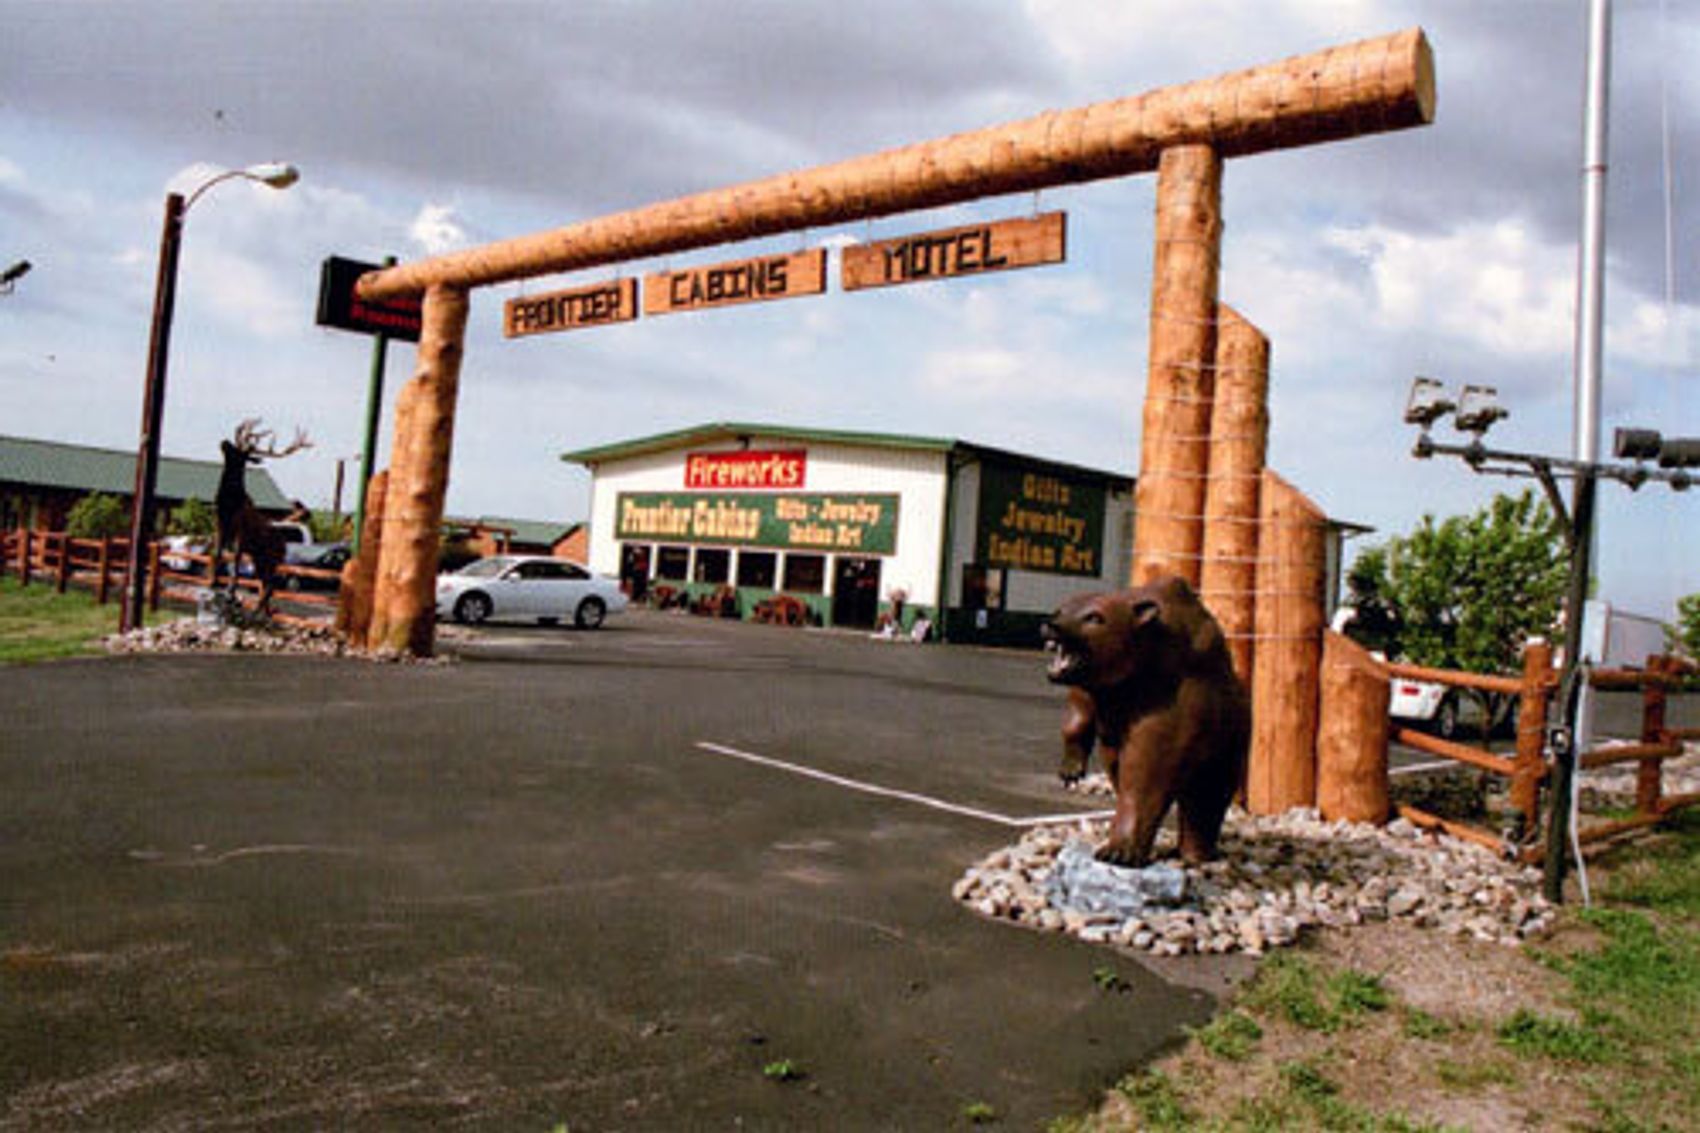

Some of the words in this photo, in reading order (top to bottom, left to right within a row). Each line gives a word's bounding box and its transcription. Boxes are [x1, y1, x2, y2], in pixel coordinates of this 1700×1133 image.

[512, 286, 621, 330] FRONTIER
[670, 259, 789, 307] CABINS
[883, 229, 1008, 280] MOTEL
[689, 453, 800, 486] Fireworks
[819, 498, 881, 526] Jewelry
[836, 524, 862, 546] Art
